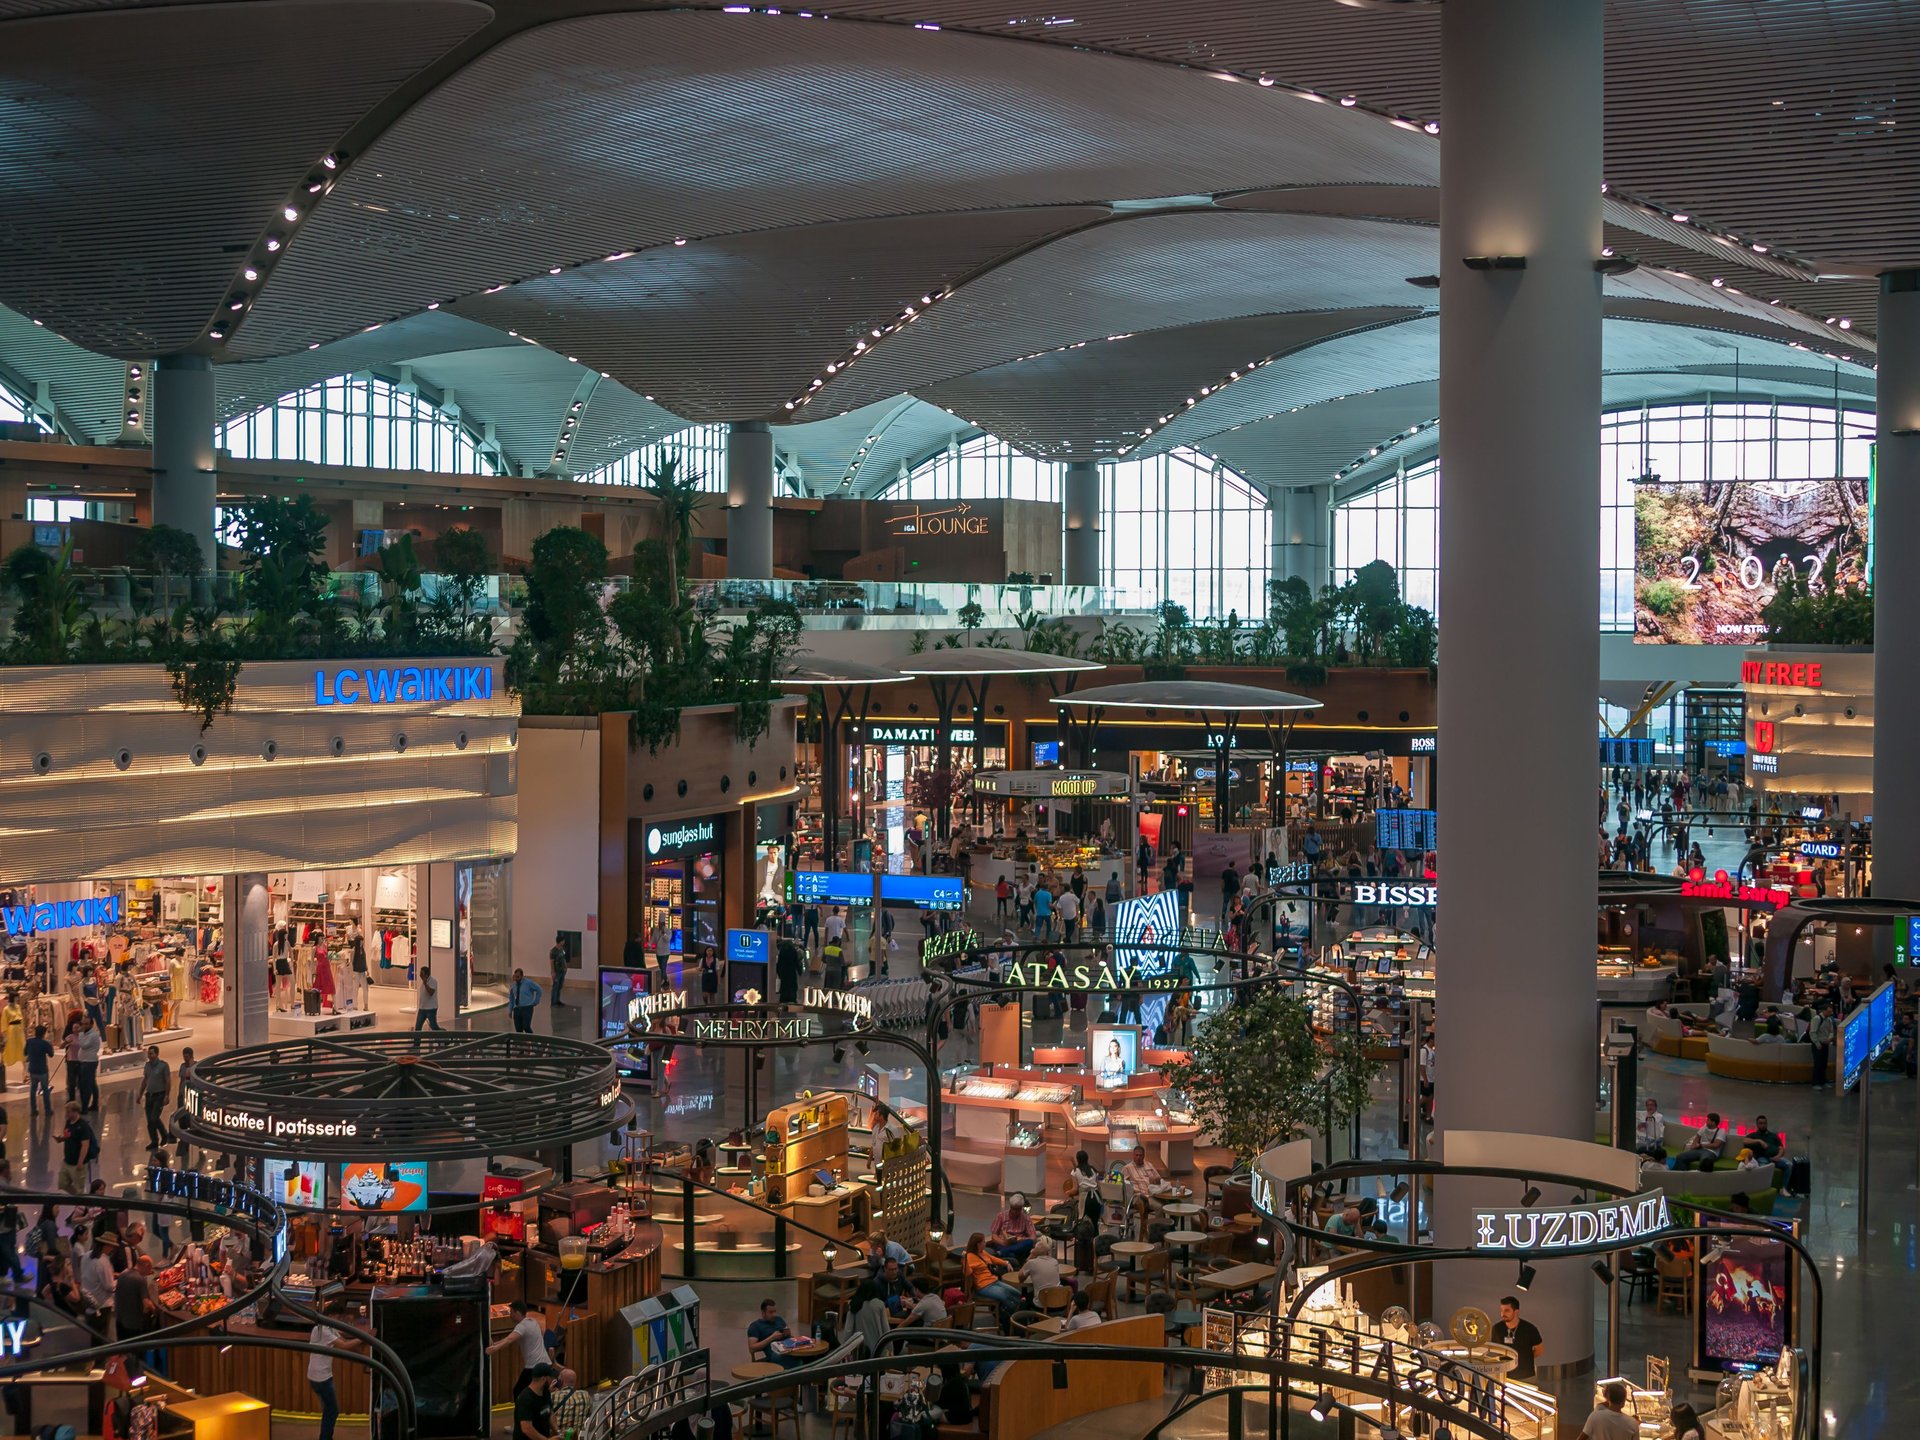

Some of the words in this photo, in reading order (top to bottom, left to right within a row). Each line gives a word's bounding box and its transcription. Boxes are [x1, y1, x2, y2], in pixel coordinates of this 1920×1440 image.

[920, 517, 989, 535] LOUNGE
[1716, 624, 1742, 634] NOW
[1765, 662, 1823, 687] FREE
[315, 669, 360, 705] LC
[872, 727, 929, 741] DAMAT
[1411, 737, 1435, 747] BOSS
[1051, 780, 1081, 796] MOOD
[1082, 779, 1097, 795] UP
[662, 825, 698, 848] sunglass
[699, 823, 714, 840] hut
[1801, 842, 1838, 856] GUARD
[812, 875, 818, 883] A
[812, 884, 818, 893] B
[933, 889, 945, 898] C4
[1004, 961, 1139, 990] ATASAY
[1147, 977, 1179, 990] 1937
[693, 1019, 770, 1039] MEHRY
[774, 1018, 812, 1039] MU
[202, 1106, 218, 1123] tea
[224, 1111, 265, 1131] coffee
[276, 1118, 357, 1137] patisserie
[1476, 1195, 1671, 1248] LUZDEMIA
